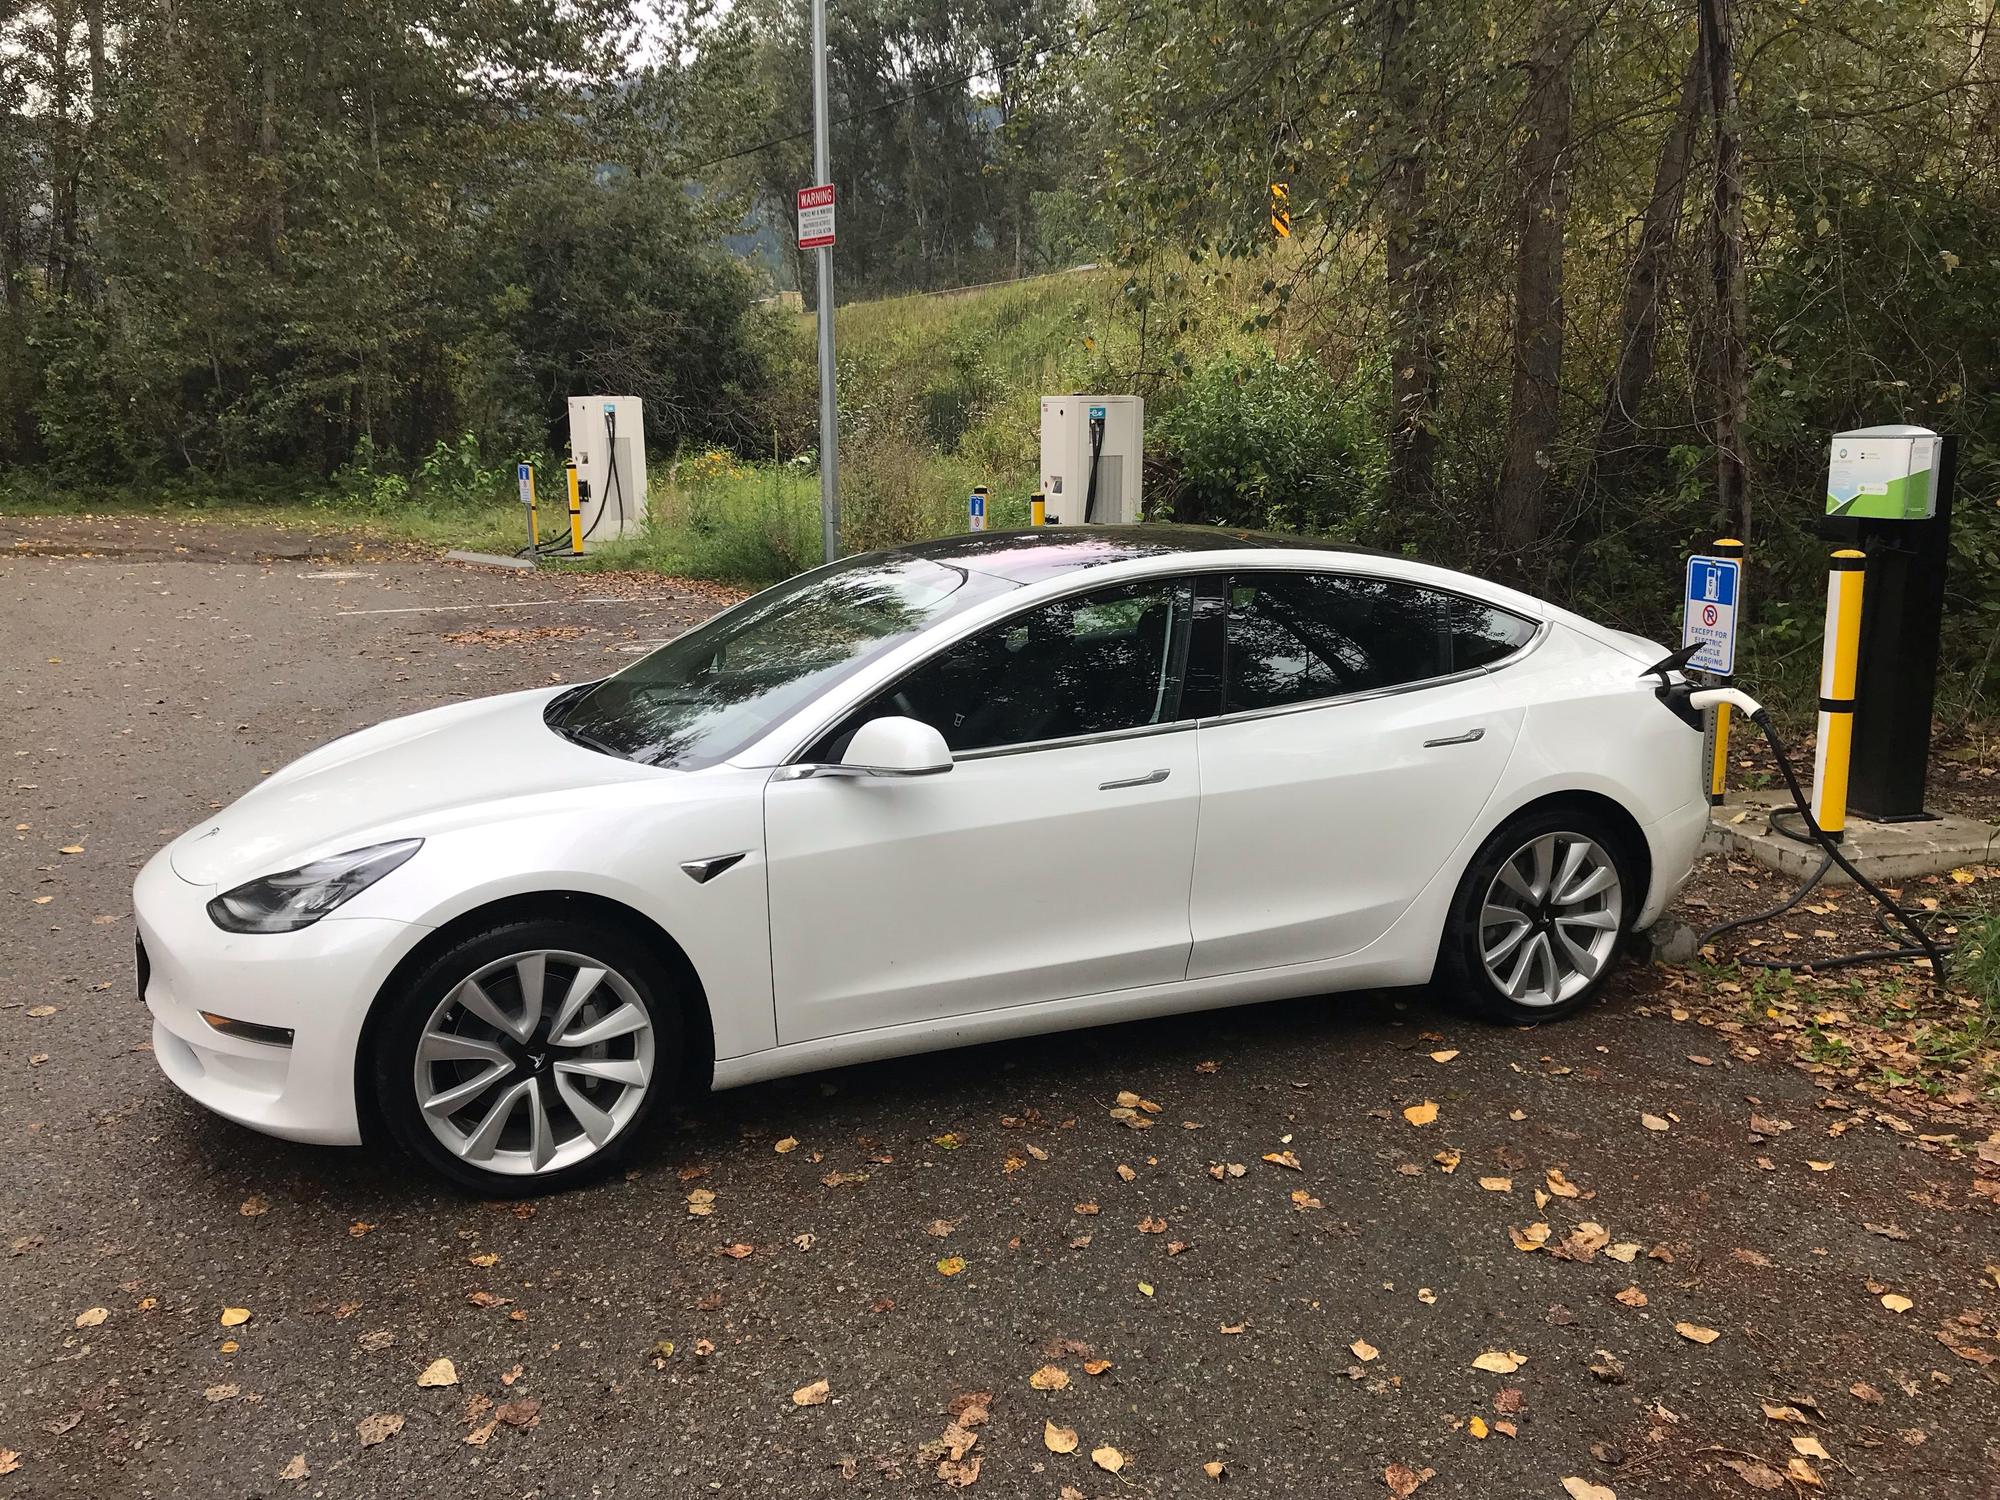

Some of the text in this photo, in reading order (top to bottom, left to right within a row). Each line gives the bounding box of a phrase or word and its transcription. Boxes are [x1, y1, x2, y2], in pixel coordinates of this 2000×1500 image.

[801, 189, 832, 207] WARNING
[1691, 626, 1727, 639] EXCEPT FOR
[1699, 647, 1721, 657] EHICLE
